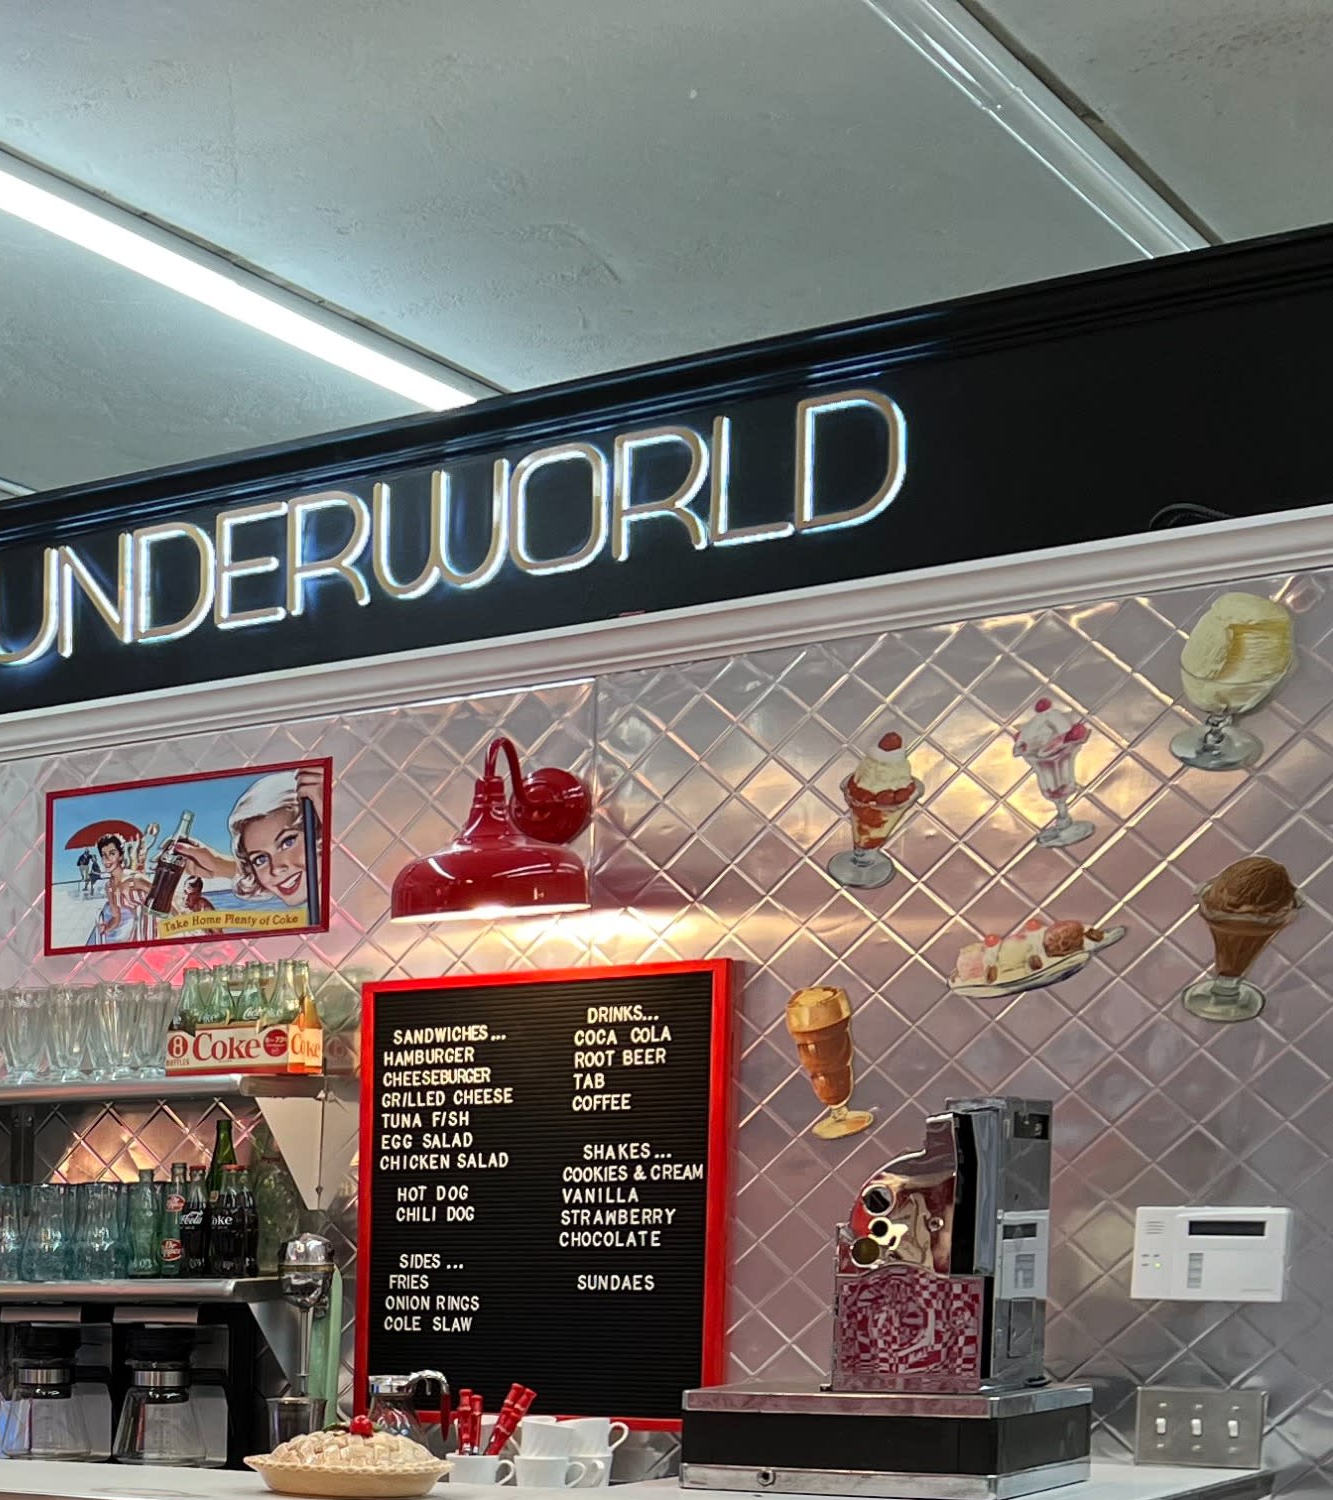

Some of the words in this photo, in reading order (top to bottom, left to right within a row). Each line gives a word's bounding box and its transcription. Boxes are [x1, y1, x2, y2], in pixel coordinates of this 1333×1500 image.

[163, 919, 189, 931] Take
[193, 915, 222, 926] Home
[225, 913, 257, 927] Plenty
[259, 915, 271, 926] of
[273, 914, 299, 925] Coke
[574, 1030, 617, 1046] COCA
[630, 1025, 672, 1043] COLA
[193, 1033, 261, 1061] Coke
[383, 1047, 475, 1066] HAMBURGER
[574, 1050, 615, 1069] ROOT
[622, 1048, 666, 1066] BEER
[383, 1067, 491, 1087] CHEESEBURGER
[573, 1072, 605, 1090] TAB
[382, 1091, 445, 1108] GRILLED
[453, 1087, 514, 1105] CHEESE
[572, 1093, 631, 1111] COFFEE
[381, 1112, 422, 1129] TUNA
[432, 1111, 470, 1127] FISH
[381, 1134, 413, 1150] EGG
[422, 1132, 473, 1149] SALAD
[380, 1154, 450, 1170] CHICKEN
[457, 1152, 509, 1169] SALAD
[562, 1165, 628, 1183] COOKIES
[633, 1164, 648, 1181] &
[650, 1164, 703, 1181] CREAM
[397, 1185, 427, 1202] HOT
[436, 1185, 469, 1201] DOG
[562, 1187, 639, 1204] VANILLA
[396, 1206, 437, 1222] CHILI
[446, 1206, 475, 1222] DOG
[560, 1208, 676, 1226] STRAWBERRY
[559, 1231, 661, 1248] CHOCOLATE
[389, 1274, 429, 1290] FRIES
[577, 1274, 655, 1290] SUNDAES
[385, 1295, 430, 1311] ONION
[436, 1295, 480, 1311] RINGS
[384, 1315, 421, 1331] COLE
[432, 1316, 472, 1332] SLAW
